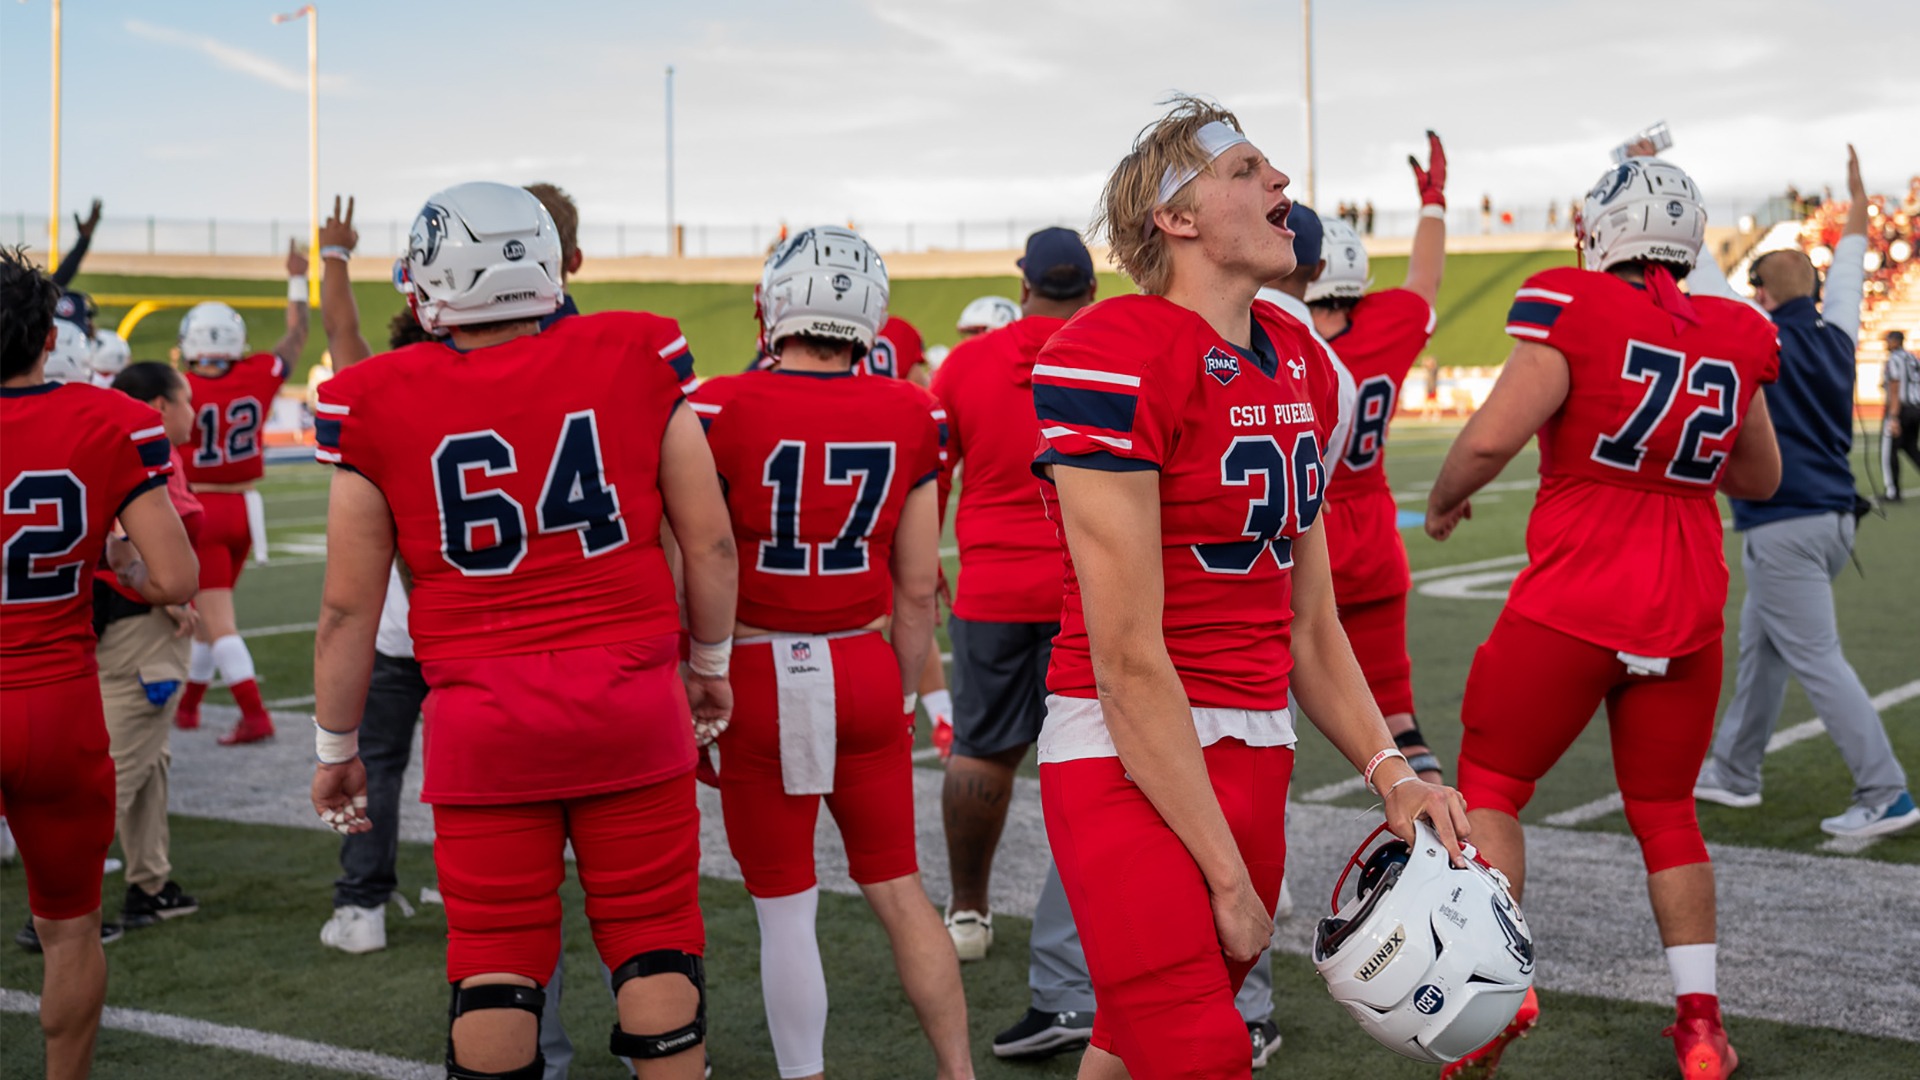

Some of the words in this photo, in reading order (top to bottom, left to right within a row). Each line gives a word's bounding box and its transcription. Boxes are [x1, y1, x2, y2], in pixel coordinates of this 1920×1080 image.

[503, 245, 525, 259] LEO
[1647, 245, 1687, 259] schutt
[495, 290, 537, 302] XENITH
[811, 320, 856, 336] schutt
[1208, 358, 1238, 371] RMAC
[1229, 404, 1266, 427] CSU
[1590, 338, 1741, 484] 72
[193, 395, 262, 467] 12
[430, 408, 630, 576] 64
[755, 439, 896, 576] 17
[1190, 430, 1326, 575] 39
[1, 468, 88, 604] 2
[1359, 932, 1403, 980] XENITH
[1415, 986, 1443, 1014] LEO
